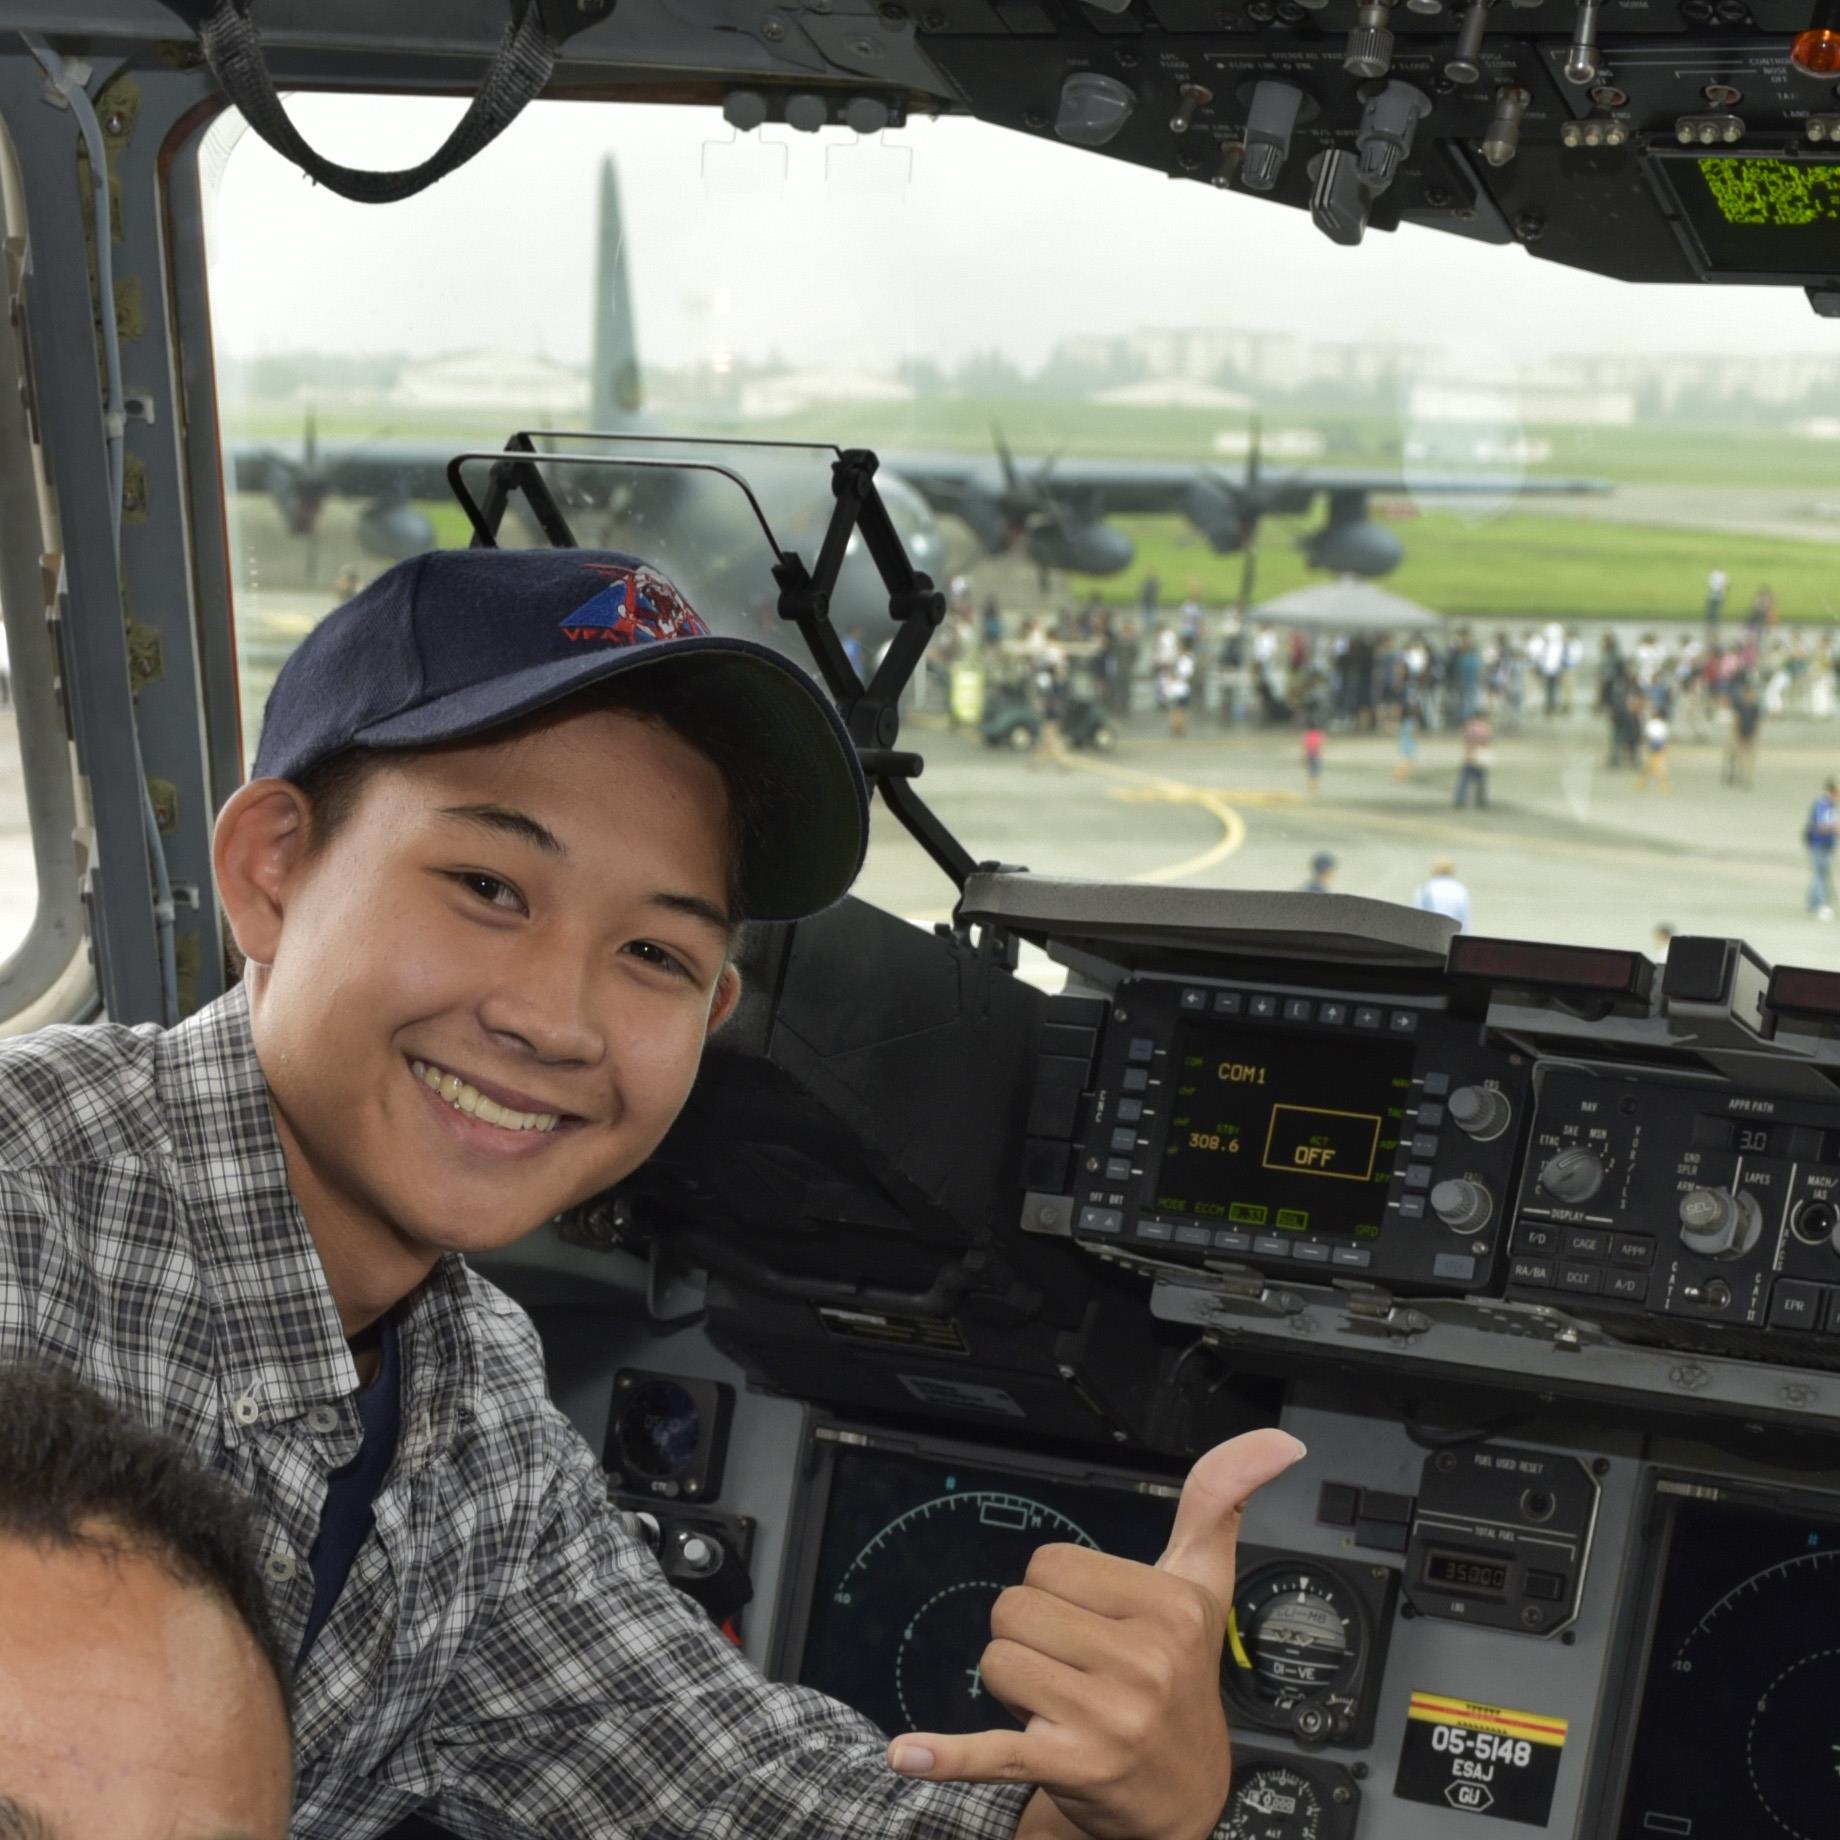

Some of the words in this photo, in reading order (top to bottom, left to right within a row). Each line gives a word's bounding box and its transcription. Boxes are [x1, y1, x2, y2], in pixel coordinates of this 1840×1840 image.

[1217, 1062, 1267, 1085] COM1
[1581, 1101, 1598, 1113] NAV
[1188, 1132, 1240, 1153] 308.6
[1740, 1130, 1767, 1152] 3.0
[1294, 1145, 1337, 1168] OFF
[1744, 1171, 1771, 1186] LAPES
[1551, 1210, 1584, 1222] DISPLAY
[1529, 1231, 1546, 1246] F/D
[1572, 1237, 1597, 1251] CAGE
[1515, 1264, 1547, 1279] RA/BA
[1566, 1271, 1589, 1284] DCLT
[1614, 1277, 1635, 1292] A/D
[1785, 1298, 1805, 1312] EPR
[1474, 1454, 1494, 1466] FUEL
[1496, 1458, 1518, 1470] USED
[1518, 1461, 1544, 1474] RESET
[1475, 1526, 1497, 1538] TOTAL
[1499, 1530, 1516, 1542] FUEL
[1431, 1725, 1532, 1767] 05-5148
[1452, 1758, 1494, 1782] ESAJ
